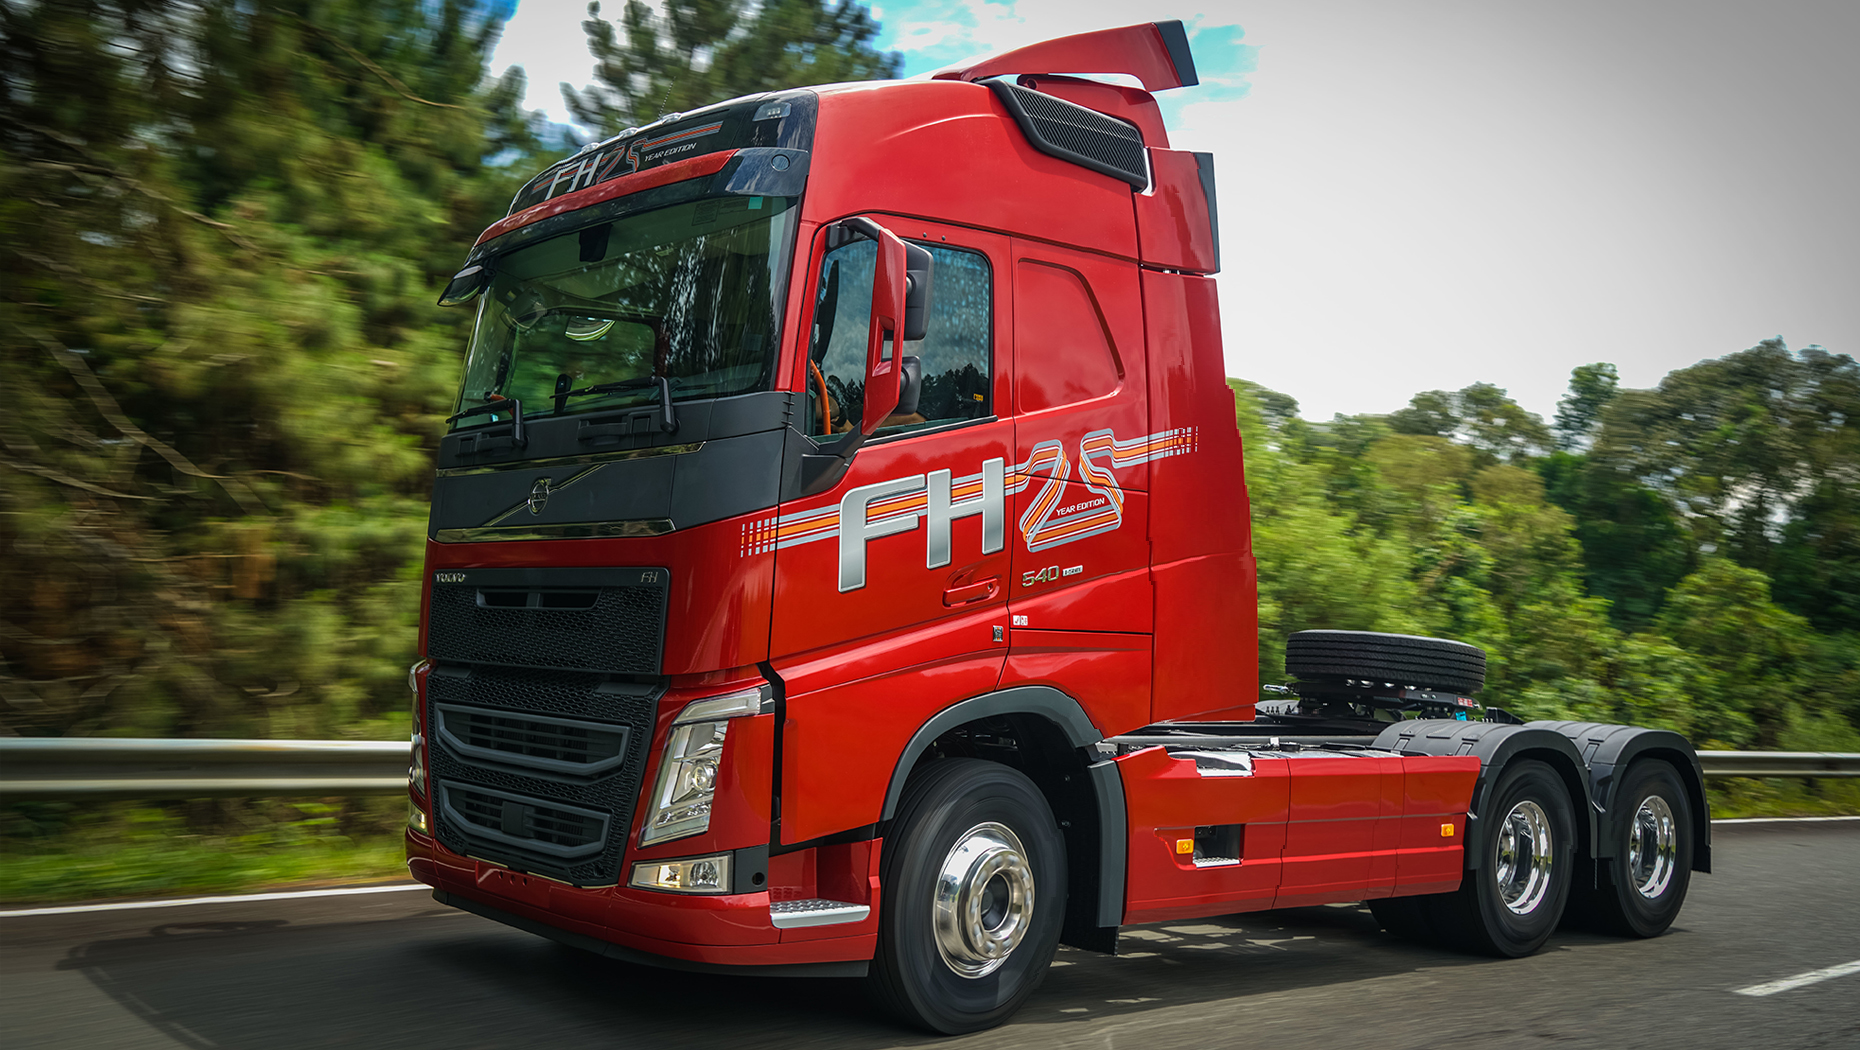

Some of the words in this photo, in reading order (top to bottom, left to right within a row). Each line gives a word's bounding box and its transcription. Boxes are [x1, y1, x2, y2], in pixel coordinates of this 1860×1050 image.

[644, 152, 664, 162] YEAR
[664, 142, 697, 156] EDITION
[1056, 505, 1076, 516] YEAR
[1076, 497, 1105, 511] EDITION
[640, 571, 658, 583] FH
[1022, 565, 1059, 587] 540
